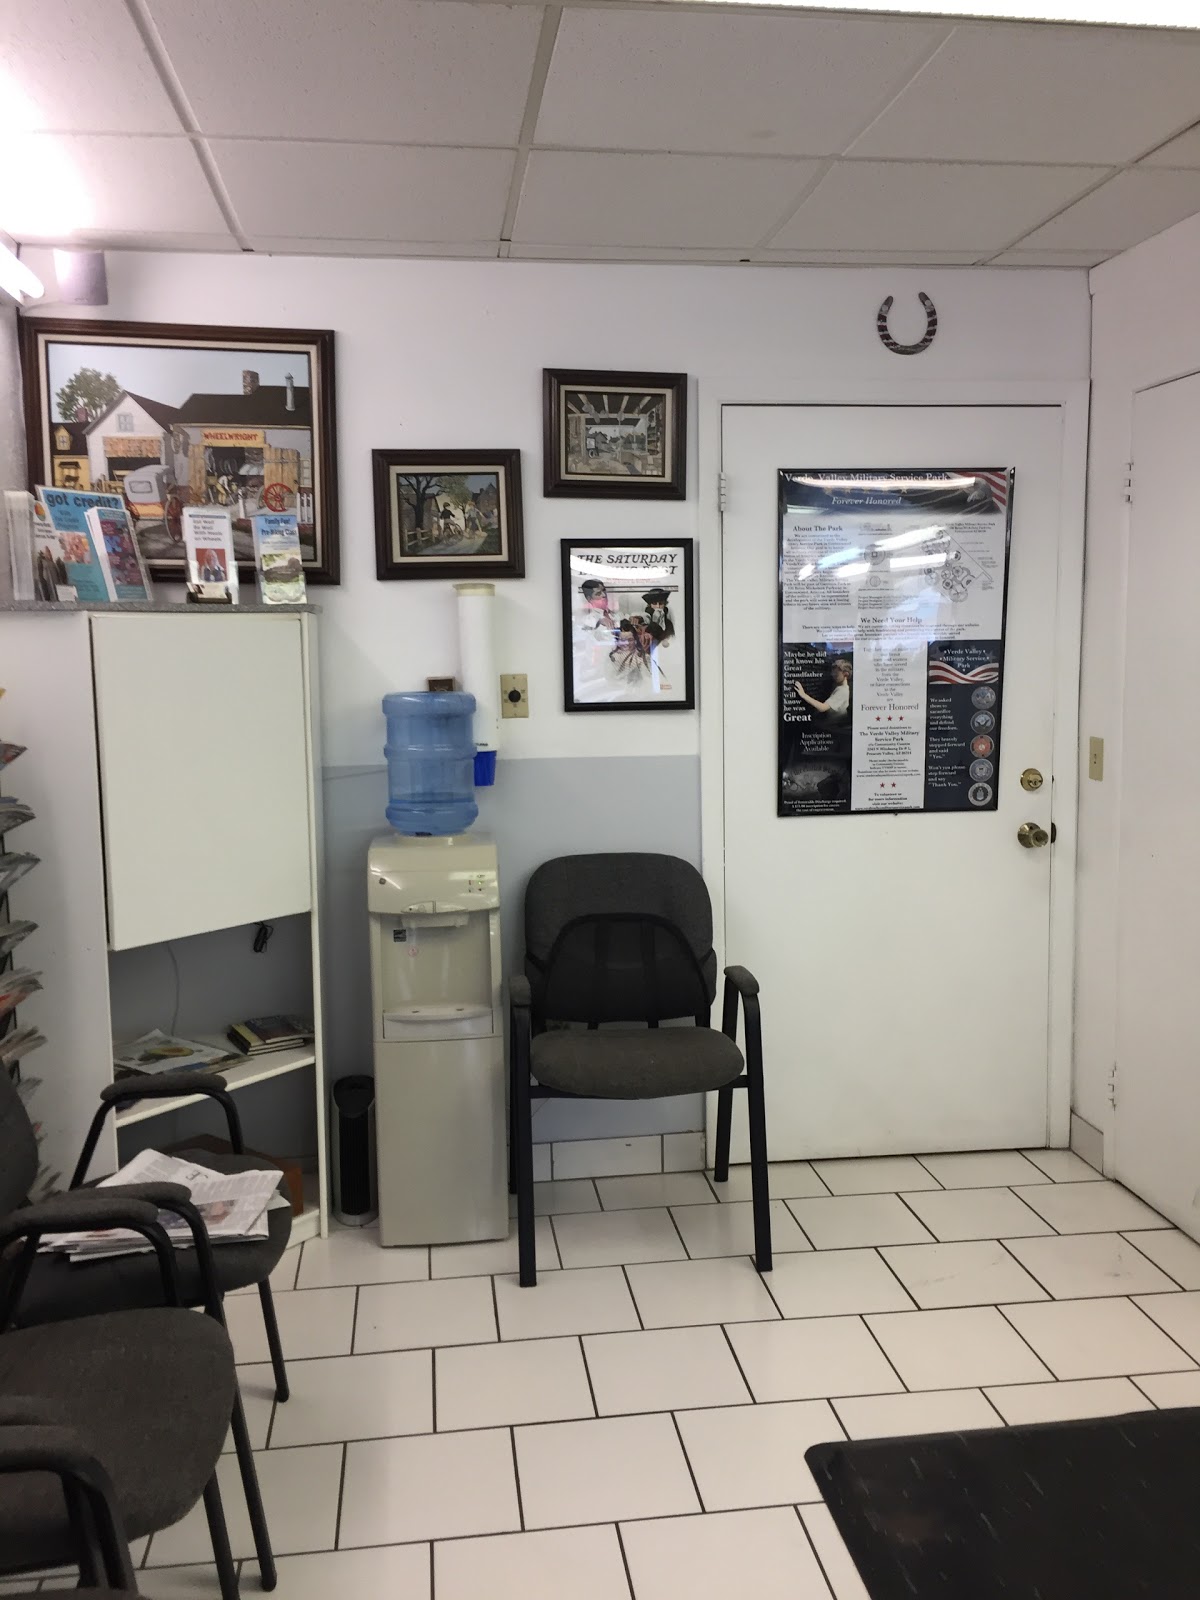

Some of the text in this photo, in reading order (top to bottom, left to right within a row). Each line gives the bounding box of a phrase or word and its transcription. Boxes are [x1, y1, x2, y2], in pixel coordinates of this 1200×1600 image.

[203, 432, 258, 441] WHEELWRIGHT
[46, 493, 119, 508] got credit?
[832, 496, 902, 505] Forever Honored
[577, 553, 677, 566] THE SATURDAY
[907, 616, 923, 624] Help
[861, 703, 919, 711] Forever Honored
[783, 713, 812, 722] Great
[801, 732, 832, 740] Inscription
